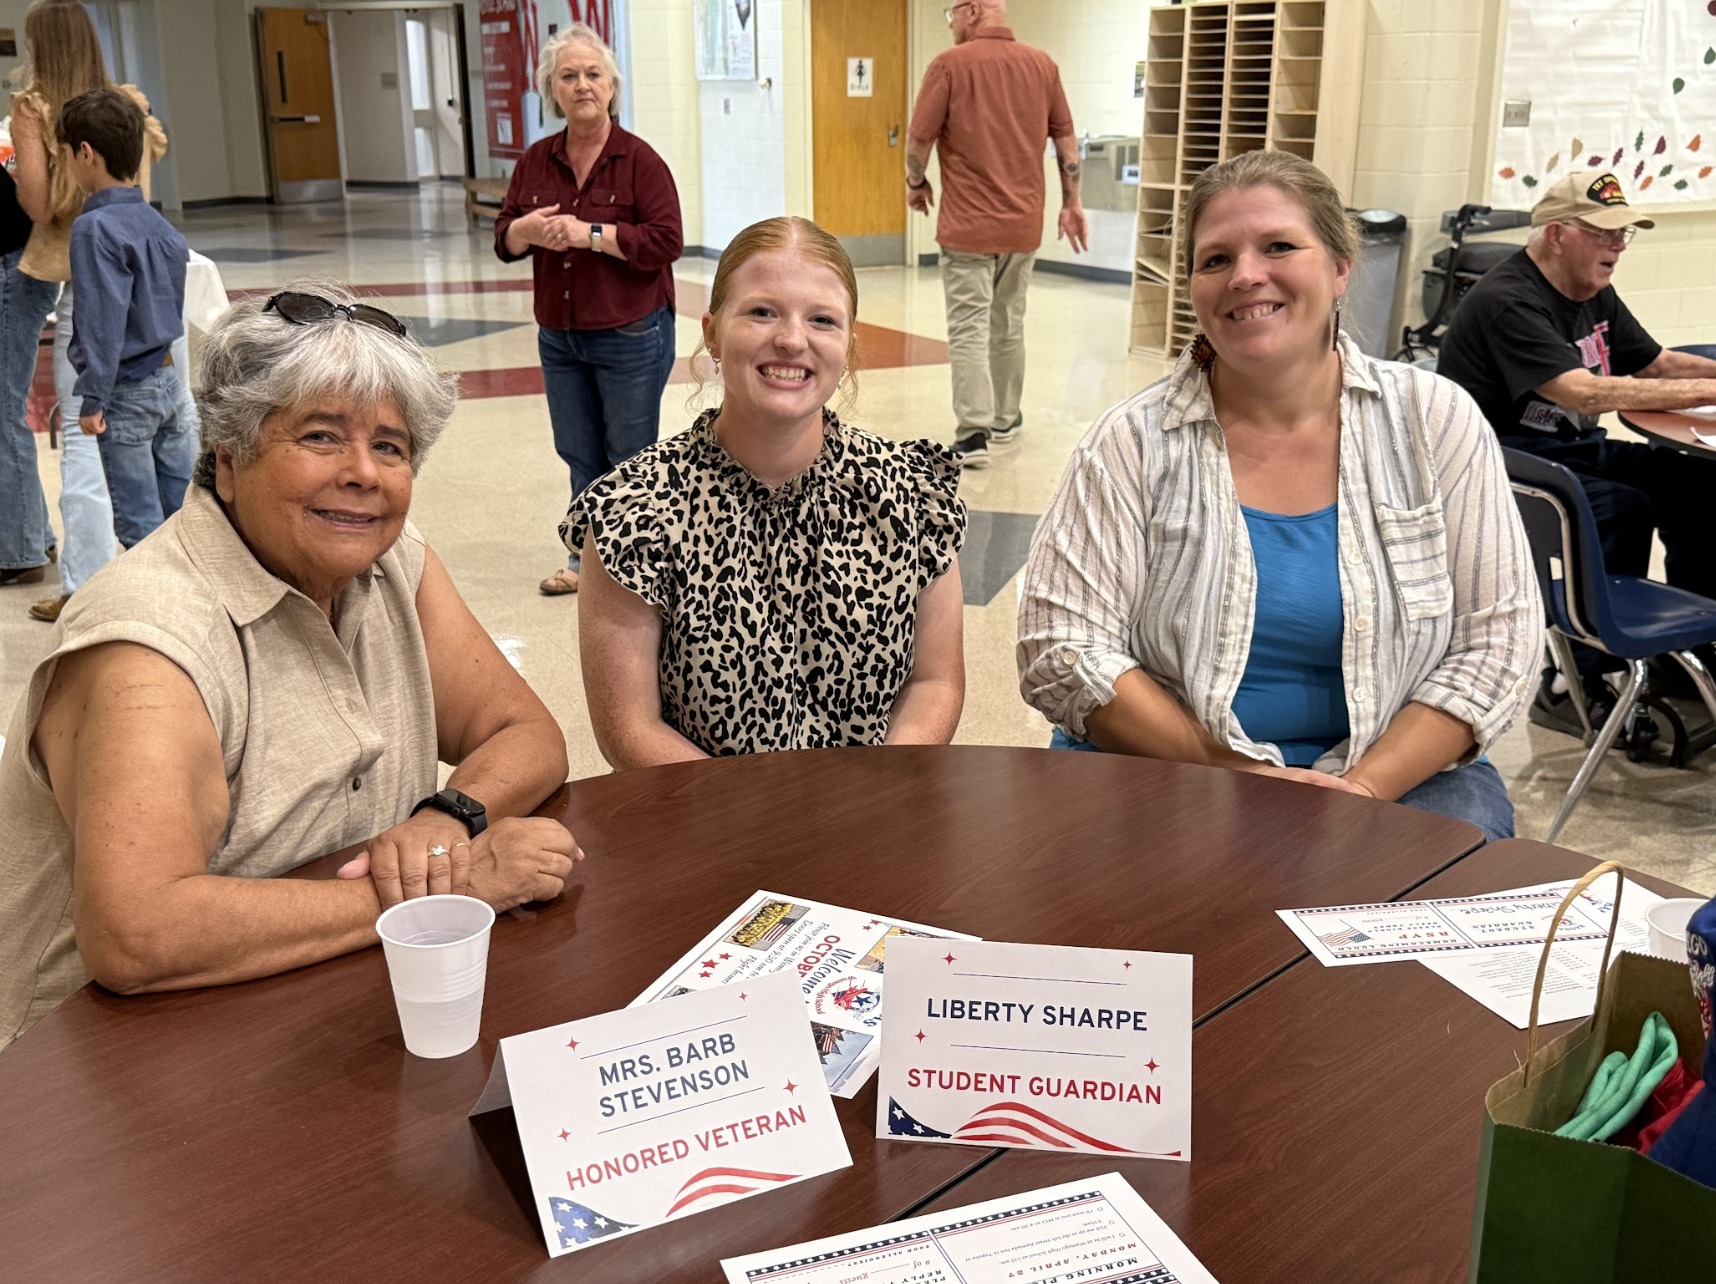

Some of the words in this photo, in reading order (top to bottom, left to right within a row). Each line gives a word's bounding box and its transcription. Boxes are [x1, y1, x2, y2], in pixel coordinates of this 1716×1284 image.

[1472, 921, 1532, 929] GUARDIAN
[1481, 925, 1534, 933] STUDENT
[1398, 931, 1449, 939] RSVP
[927, 998, 1034, 1023] LIBERTY
[1042, 1005, 1147, 1031] SHARPE
[599, 1054, 661, 1087] MRS.
[666, 1033, 736, 1068] BARB
[599, 1059, 749, 1117] STEVENSON
[907, 1068, 1021, 1094] STUDENT
[1029, 1076, 1161, 1105] GUARDIAN
[566, 1139, 689, 1191] HONORED
[694, 1104, 807, 1152] VETERAN
[907, 1244, 930, 1253] FOOD
[1062, 1241, 1087, 1250] Wamego
[1076, 1242, 1137, 1260] MONDAY,
[1028, 1251, 1047, 1259] School
[913, 1260, 922, 1270] of
[1030, 1258, 1069, 1272] APRIL
[1066, 1257, 1138, 1280] MORNING
[839, 1272, 869, 1284] guests
[901, 1269, 942, 1284] REPLY
